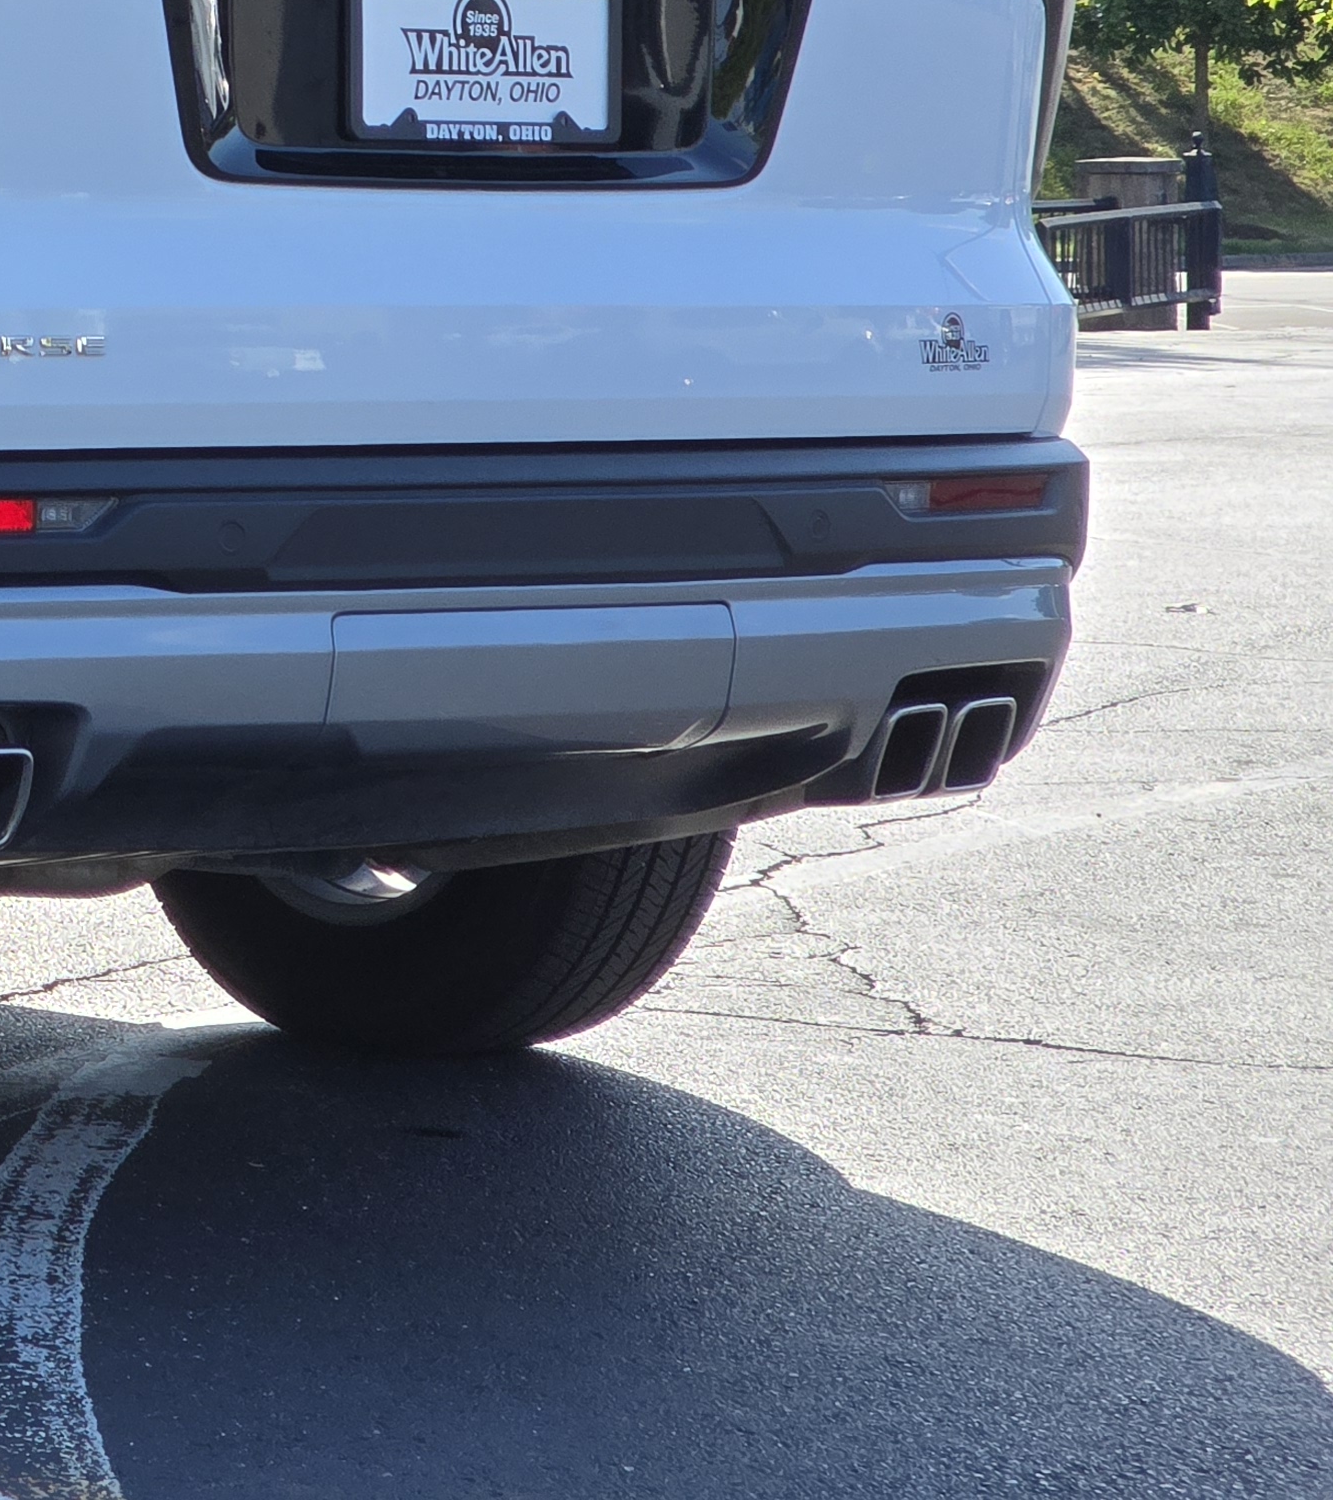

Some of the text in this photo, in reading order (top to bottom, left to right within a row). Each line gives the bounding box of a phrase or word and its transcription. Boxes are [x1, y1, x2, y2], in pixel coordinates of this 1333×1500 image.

[466, 10, 500, 24] Since
[468, 24, 498, 38] 1935
[414, 79, 562, 106] DAYTON, OHIO
[426, 123, 553, 143] DAYTON, OHIO
